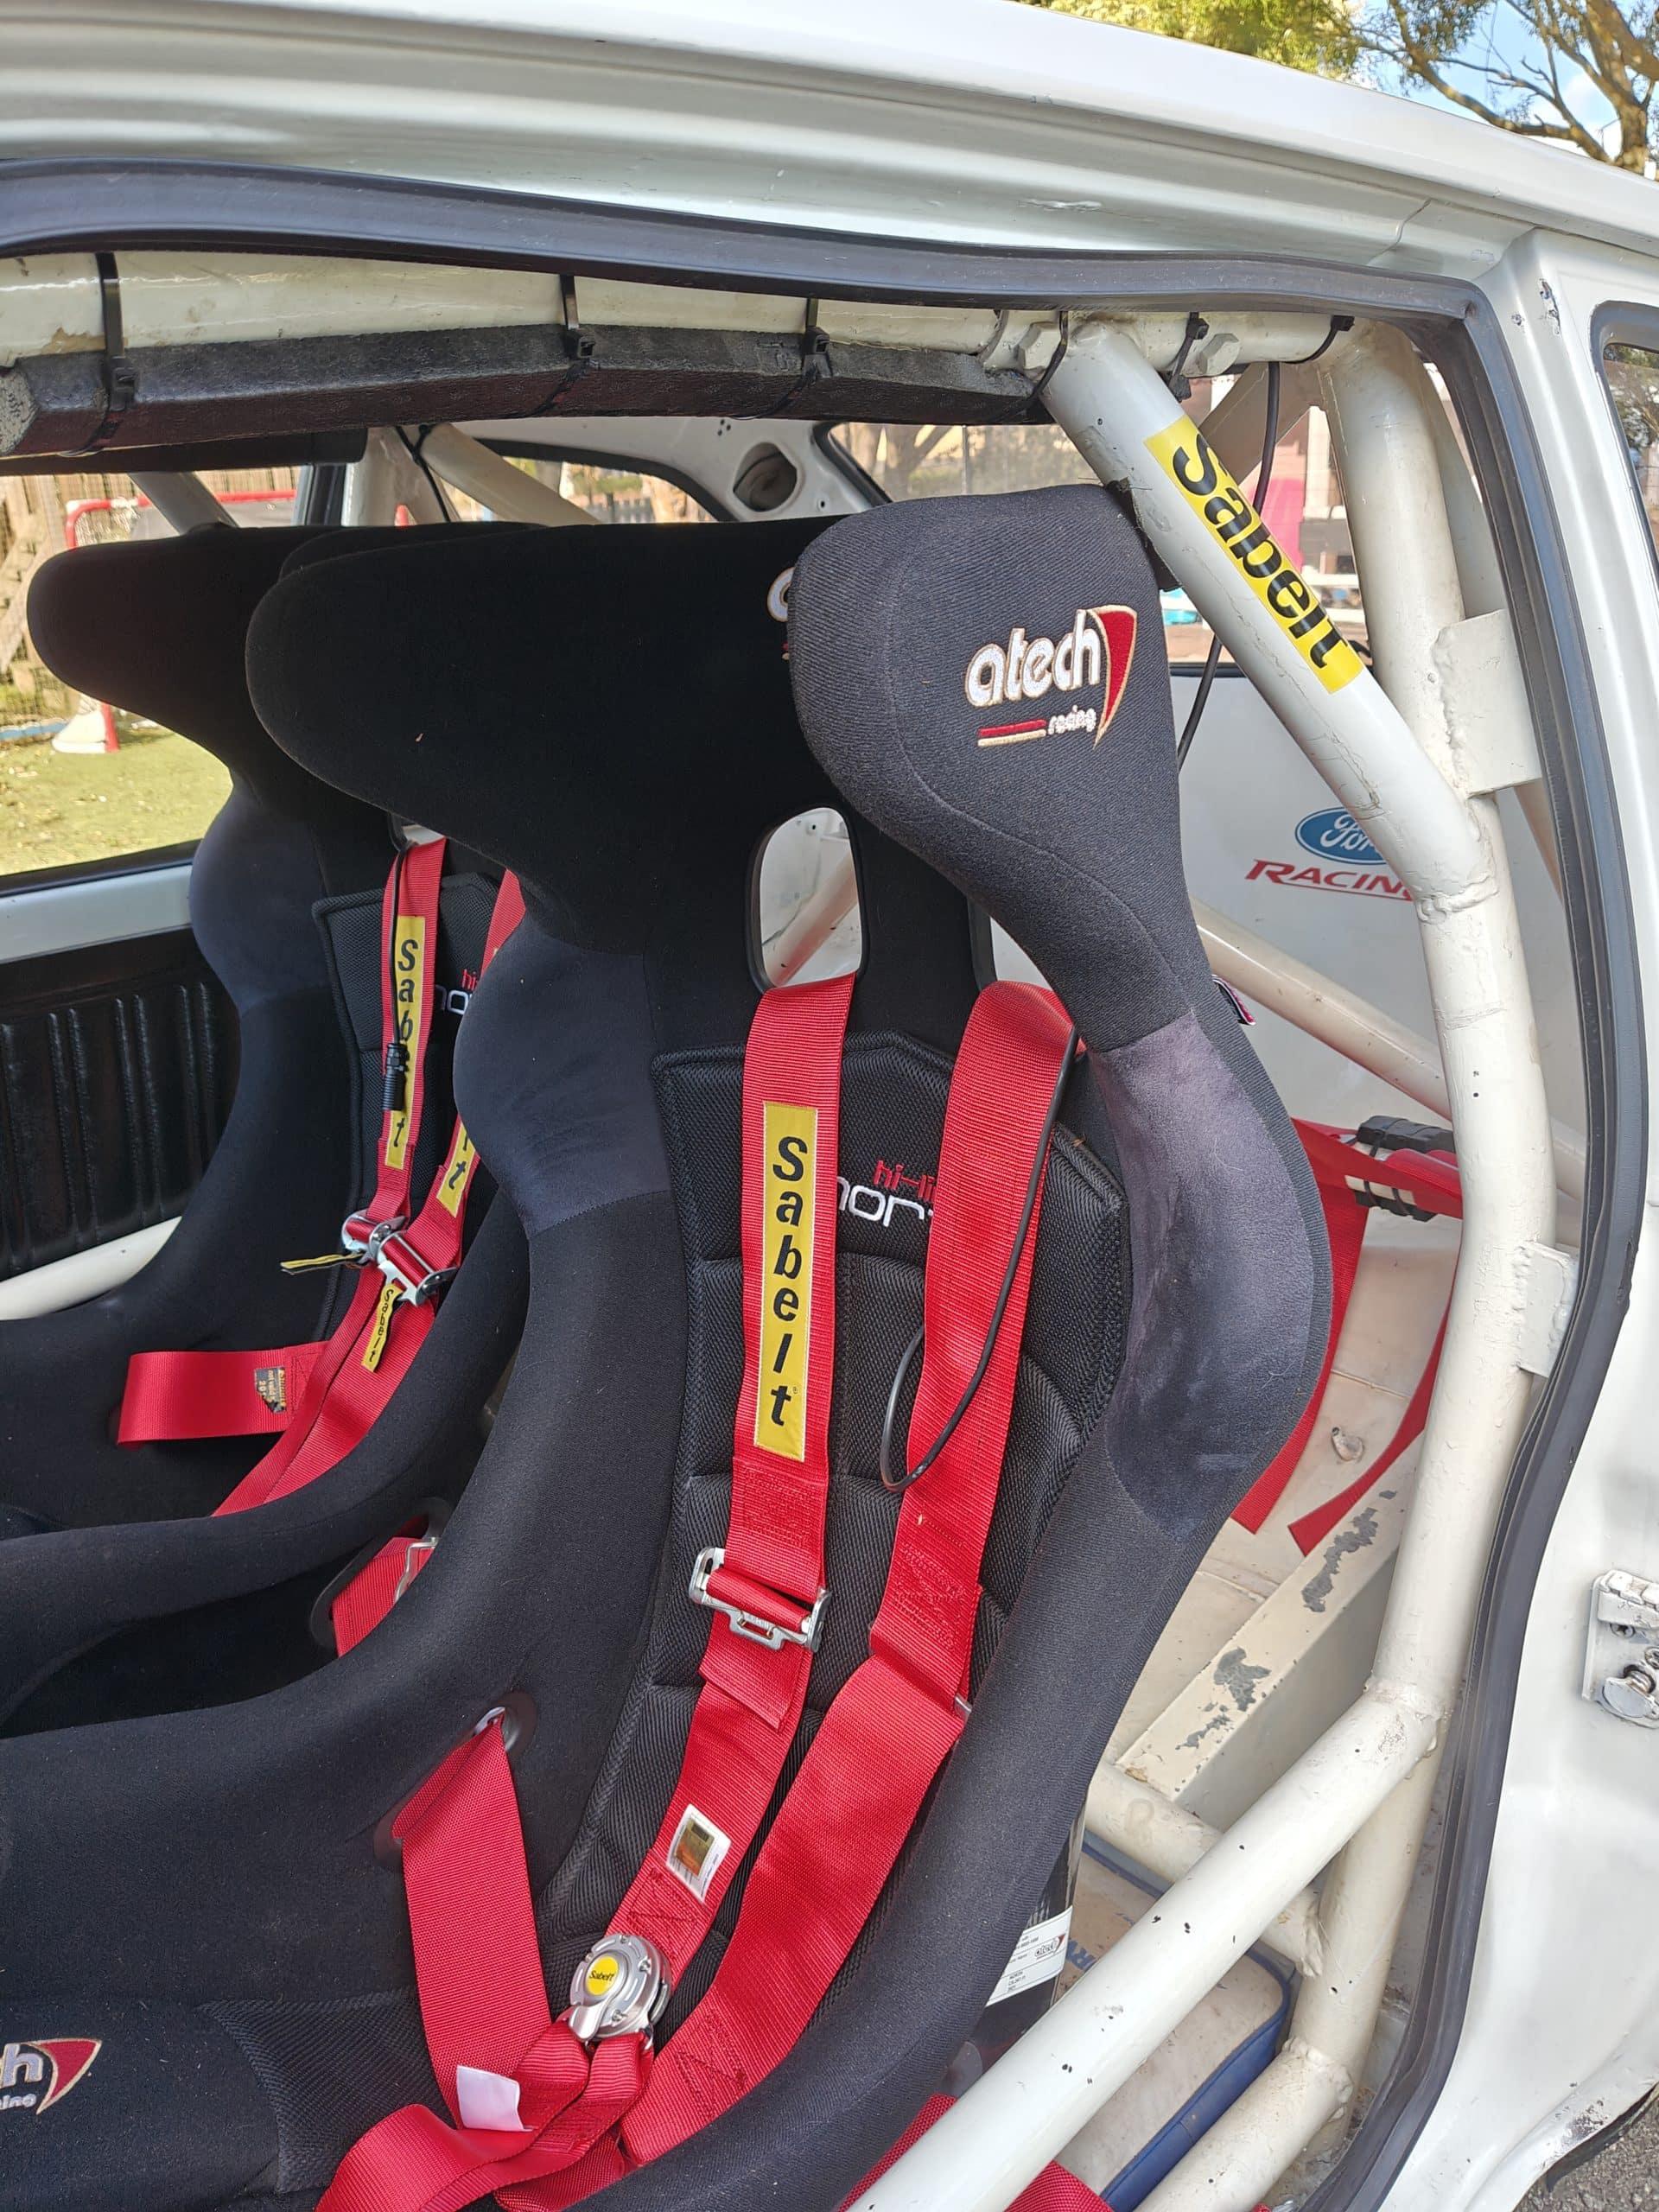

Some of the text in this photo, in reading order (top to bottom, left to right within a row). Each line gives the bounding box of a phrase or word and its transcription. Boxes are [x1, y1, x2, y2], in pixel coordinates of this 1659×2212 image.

[1173, 433, 1348, 669] Sabelt
[965, 608, 1101, 708] atech
[1047, 704, 1097, 734] racing
[1320, 814, 1382, 855] For
[369, 1288, 395, 1363] Sabelt
[589, 1970, 614, 1981] Sabelt
